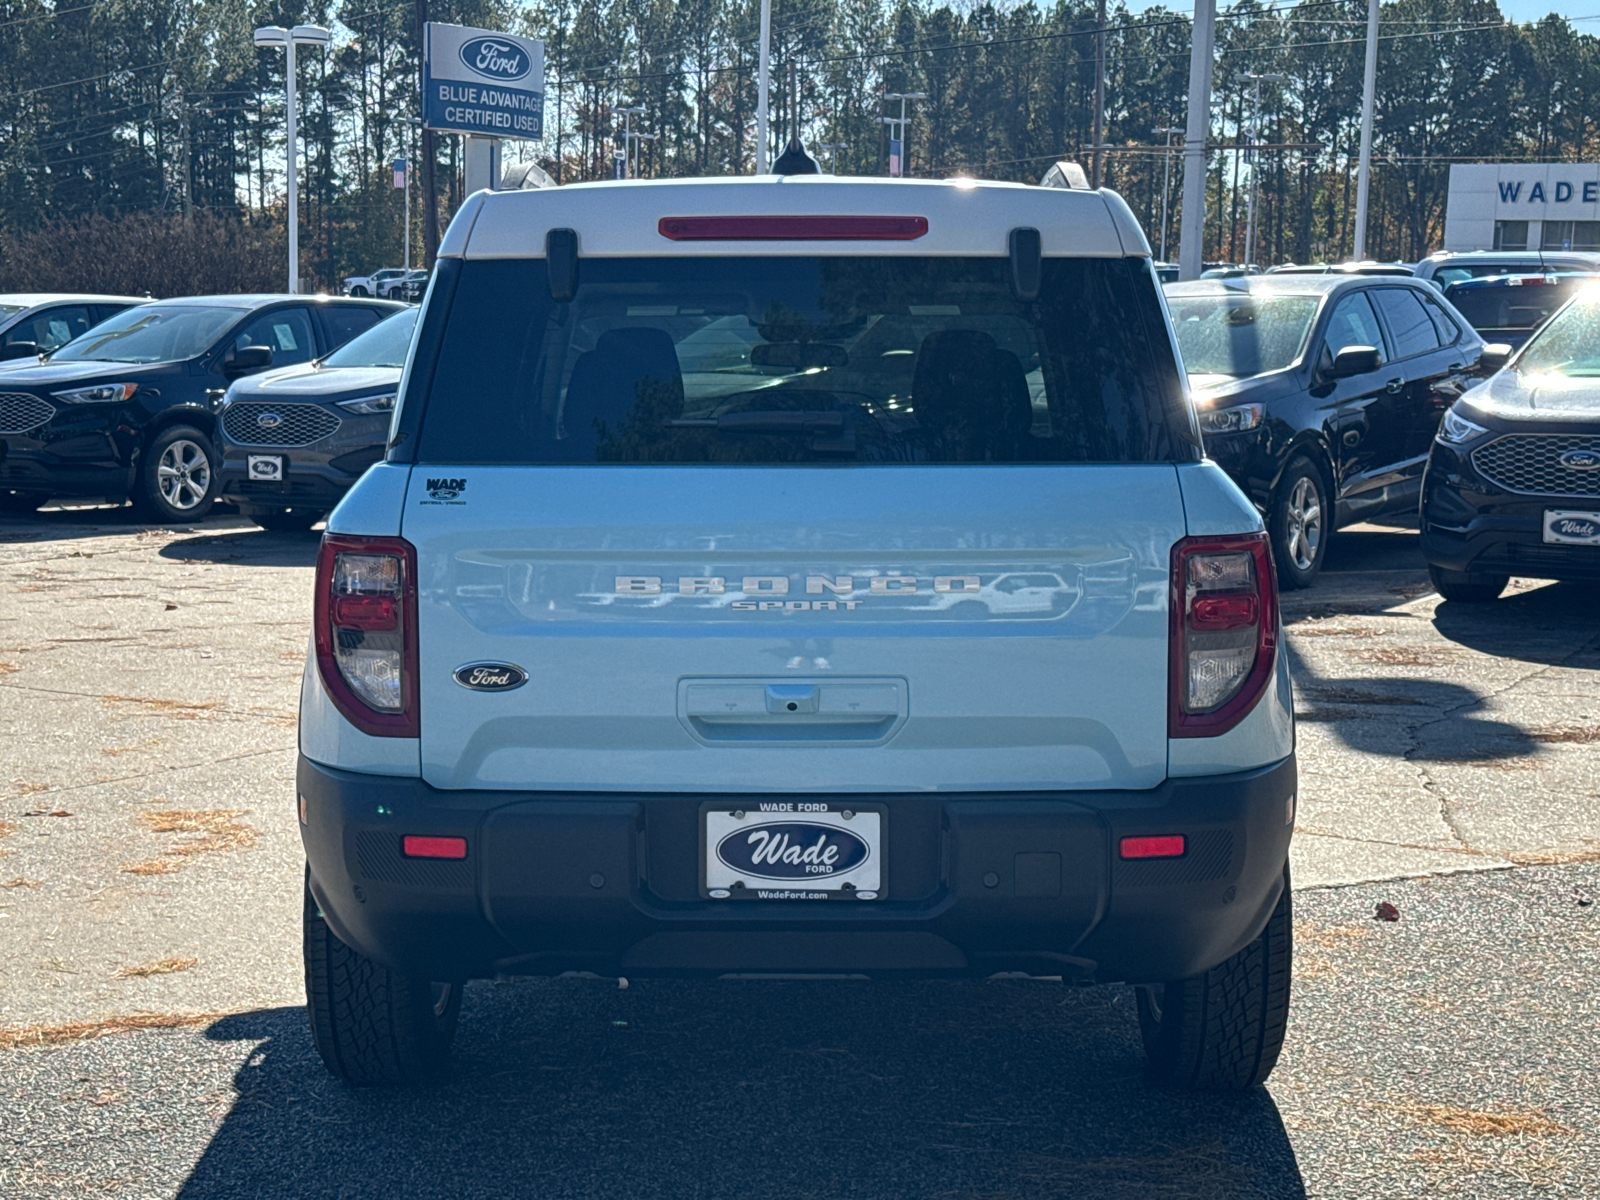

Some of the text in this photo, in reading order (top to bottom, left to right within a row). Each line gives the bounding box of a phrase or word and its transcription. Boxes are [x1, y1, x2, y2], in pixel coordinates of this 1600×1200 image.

[476, 41, 520, 75] Ford
[439, 85, 541, 113] BLUE ADVANTAGE
[445, 106, 539, 132] CERTIFIED USED
[1498, 181, 1599, 203] WADE
[1570, 454, 1595, 465] Ford
[426, 478, 467, 491] WADE
[1560, 520, 1594, 534] Wade
[615, 575, 981, 594] BRONCO
[731, 600, 864, 611] SPORT
[469, 667, 511, 685] Ford
[759, 803, 828, 812] WADE FORD
[747, 830, 839, 865] Wade
[805, 865, 833, 873] FORD
[758, 891, 828, 900] WadeFord.com
